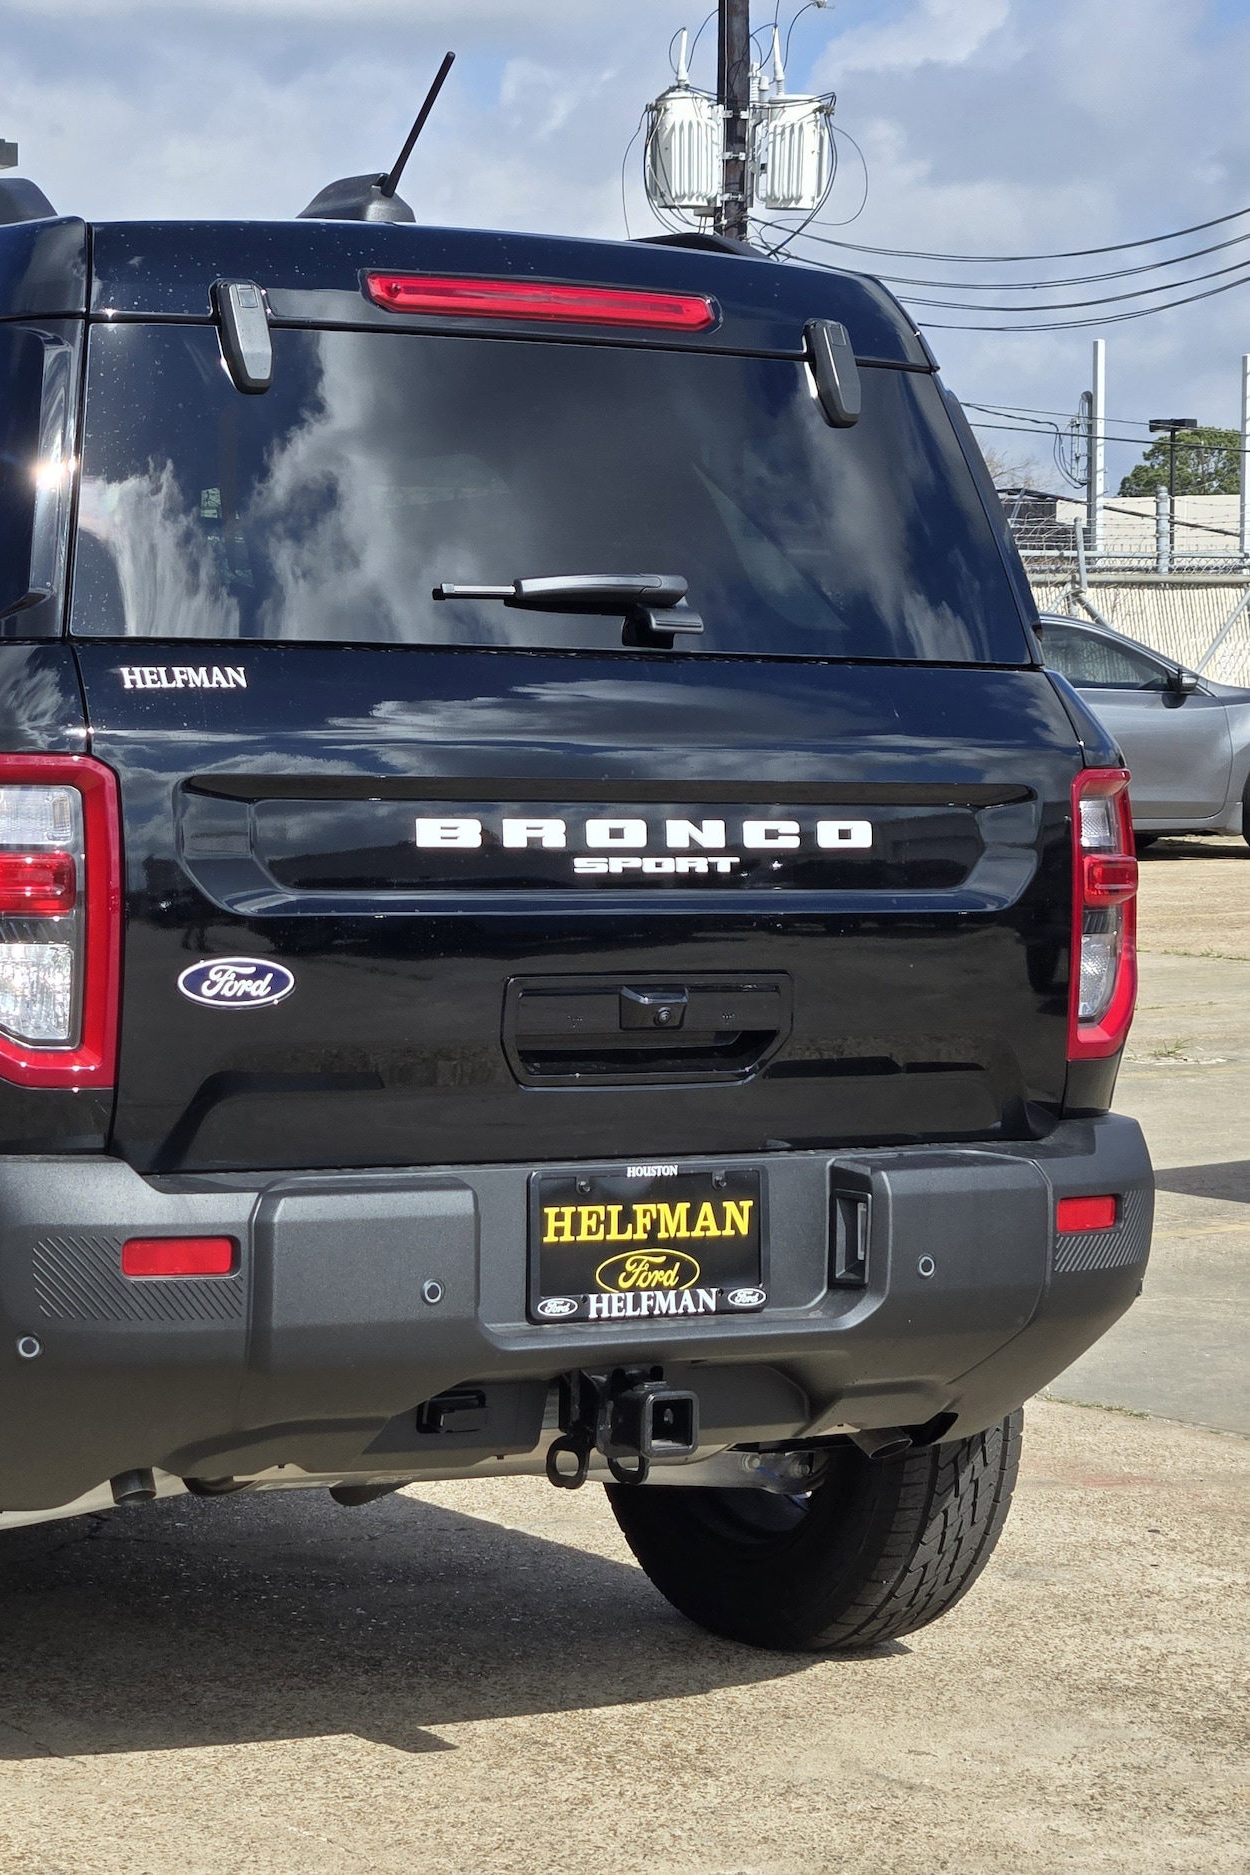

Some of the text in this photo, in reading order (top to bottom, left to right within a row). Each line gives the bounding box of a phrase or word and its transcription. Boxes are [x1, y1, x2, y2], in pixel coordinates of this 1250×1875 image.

[120, 666, 248, 689] HELFMAN
[414, 817, 874, 850] BRONCO
[573, 856, 741, 874] SPORT
[201, 964, 274, 998] Ford
[626, 1164, 679, 1178] HOUSTON
[542, 1199, 754, 1243] HELFMAN
[617, 1254, 681, 1289] Ford
[587, 1287, 718, 1319] HELFMAN
